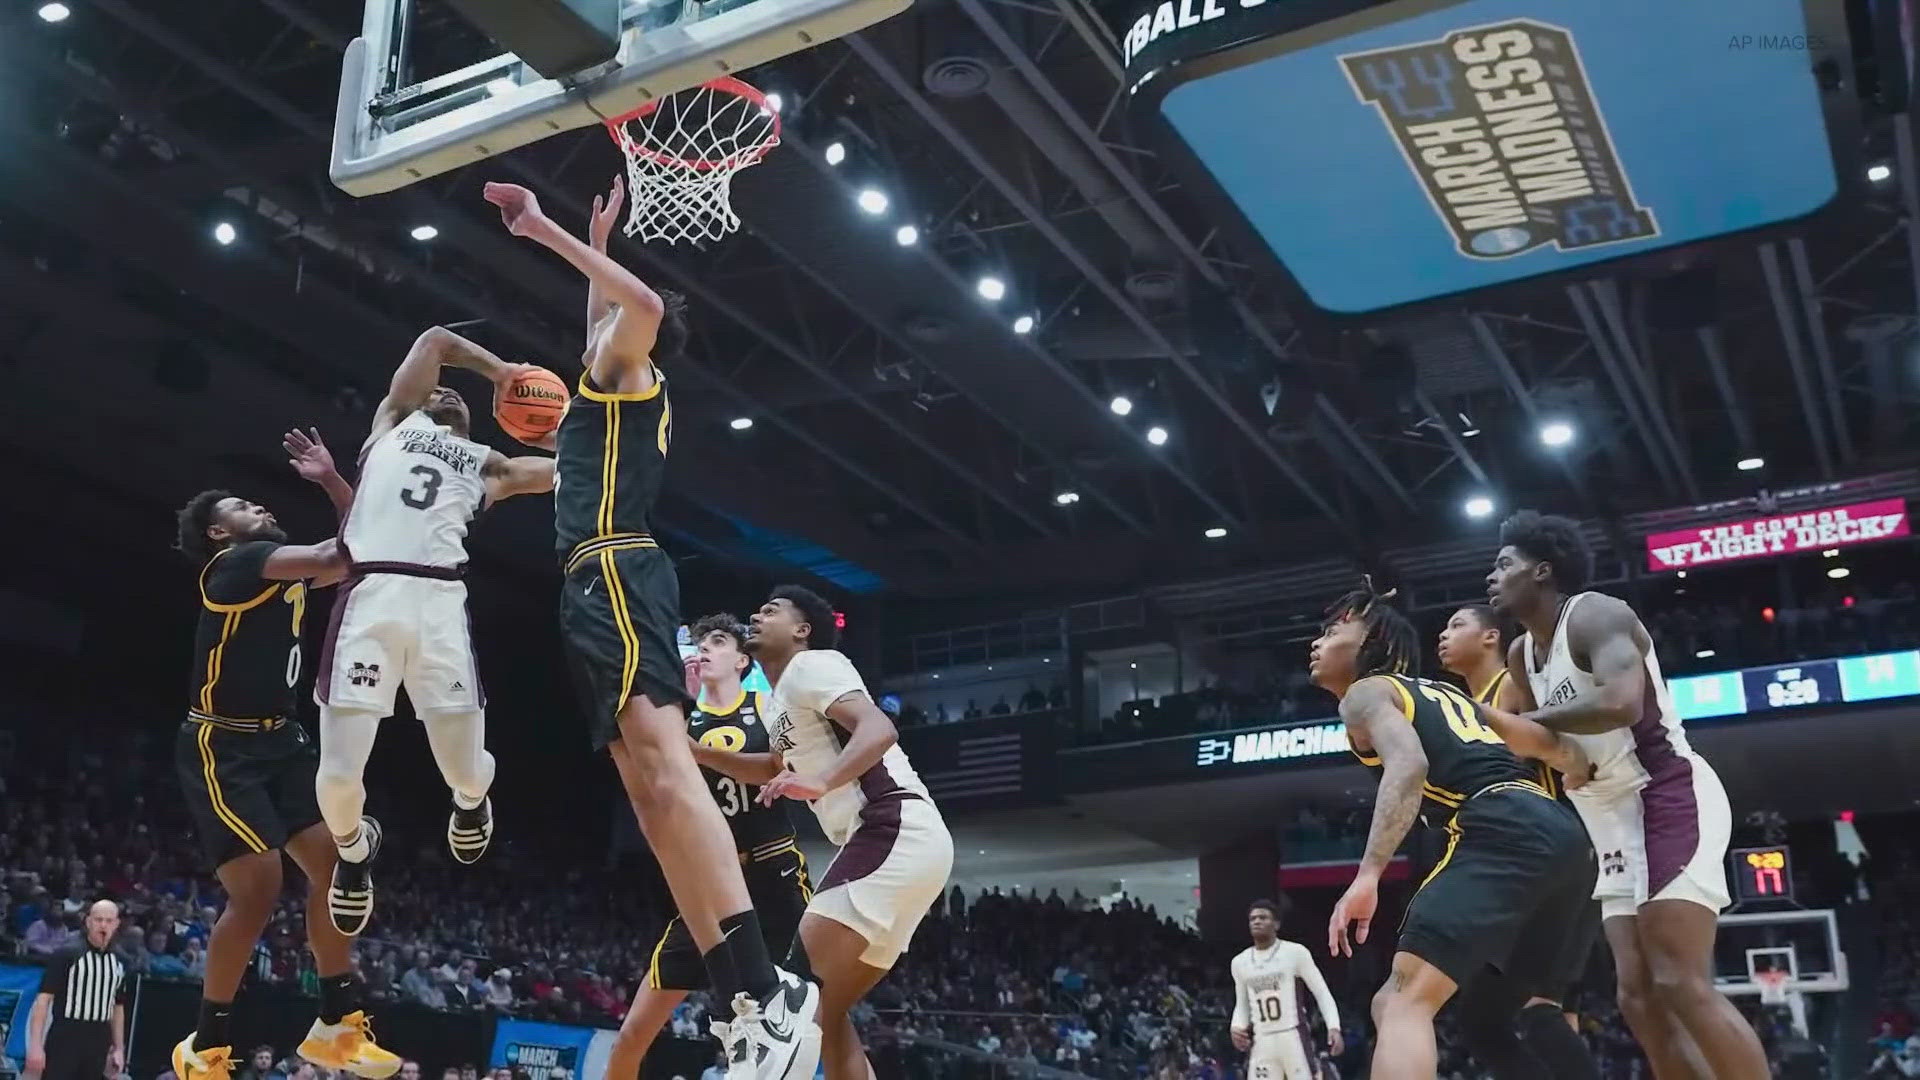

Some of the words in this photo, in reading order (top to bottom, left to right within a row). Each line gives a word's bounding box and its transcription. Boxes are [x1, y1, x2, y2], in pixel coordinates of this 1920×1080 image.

[1453, 28, 1594, 204] MADNESS
[1406, 116, 1529, 231] MARCH
[515, 384, 565, 403] Wilson
[401, 465, 443, 510] 3
[1670, 528, 1787, 565] FLIGHT
[1794, 515, 1885, 548] DECK
[1699, 525, 1744, 542] THE
[717, 777, 749, 817] 31
[1256, 996, 1281, 1022] 10
[518, 1046, 559, 1067] MARCH
